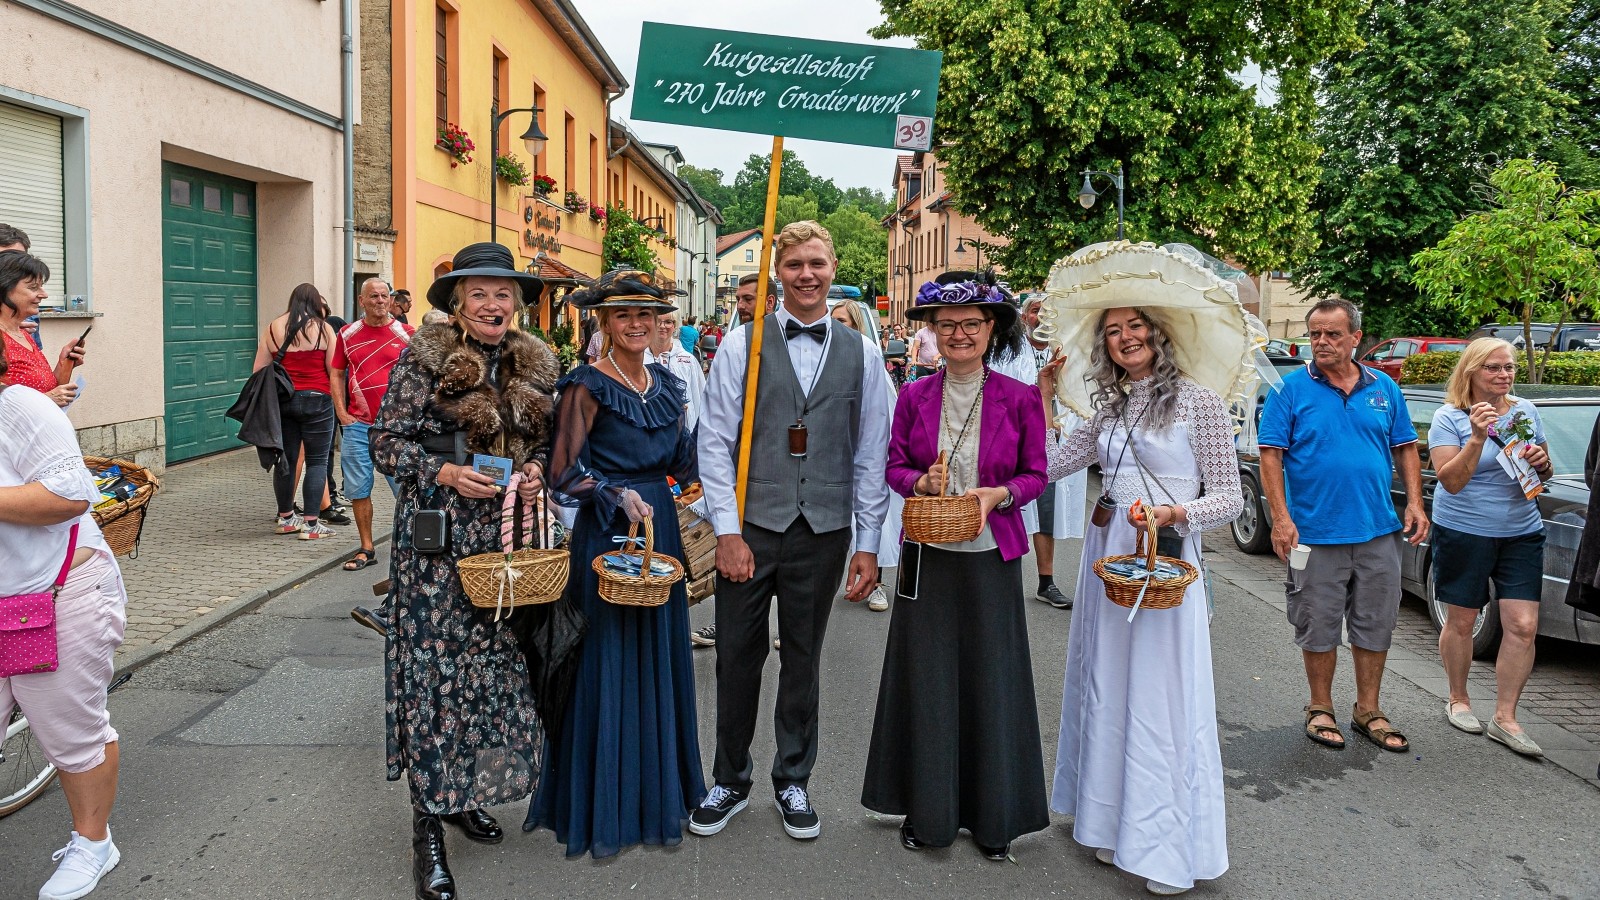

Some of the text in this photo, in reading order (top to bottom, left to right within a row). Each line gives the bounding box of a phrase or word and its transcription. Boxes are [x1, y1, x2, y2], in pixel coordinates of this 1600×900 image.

[703, 42, 876, 86] Kurgesellschaft
[701, 82, 766, 114] Jahre
[900, 120, 926, 143] 39
